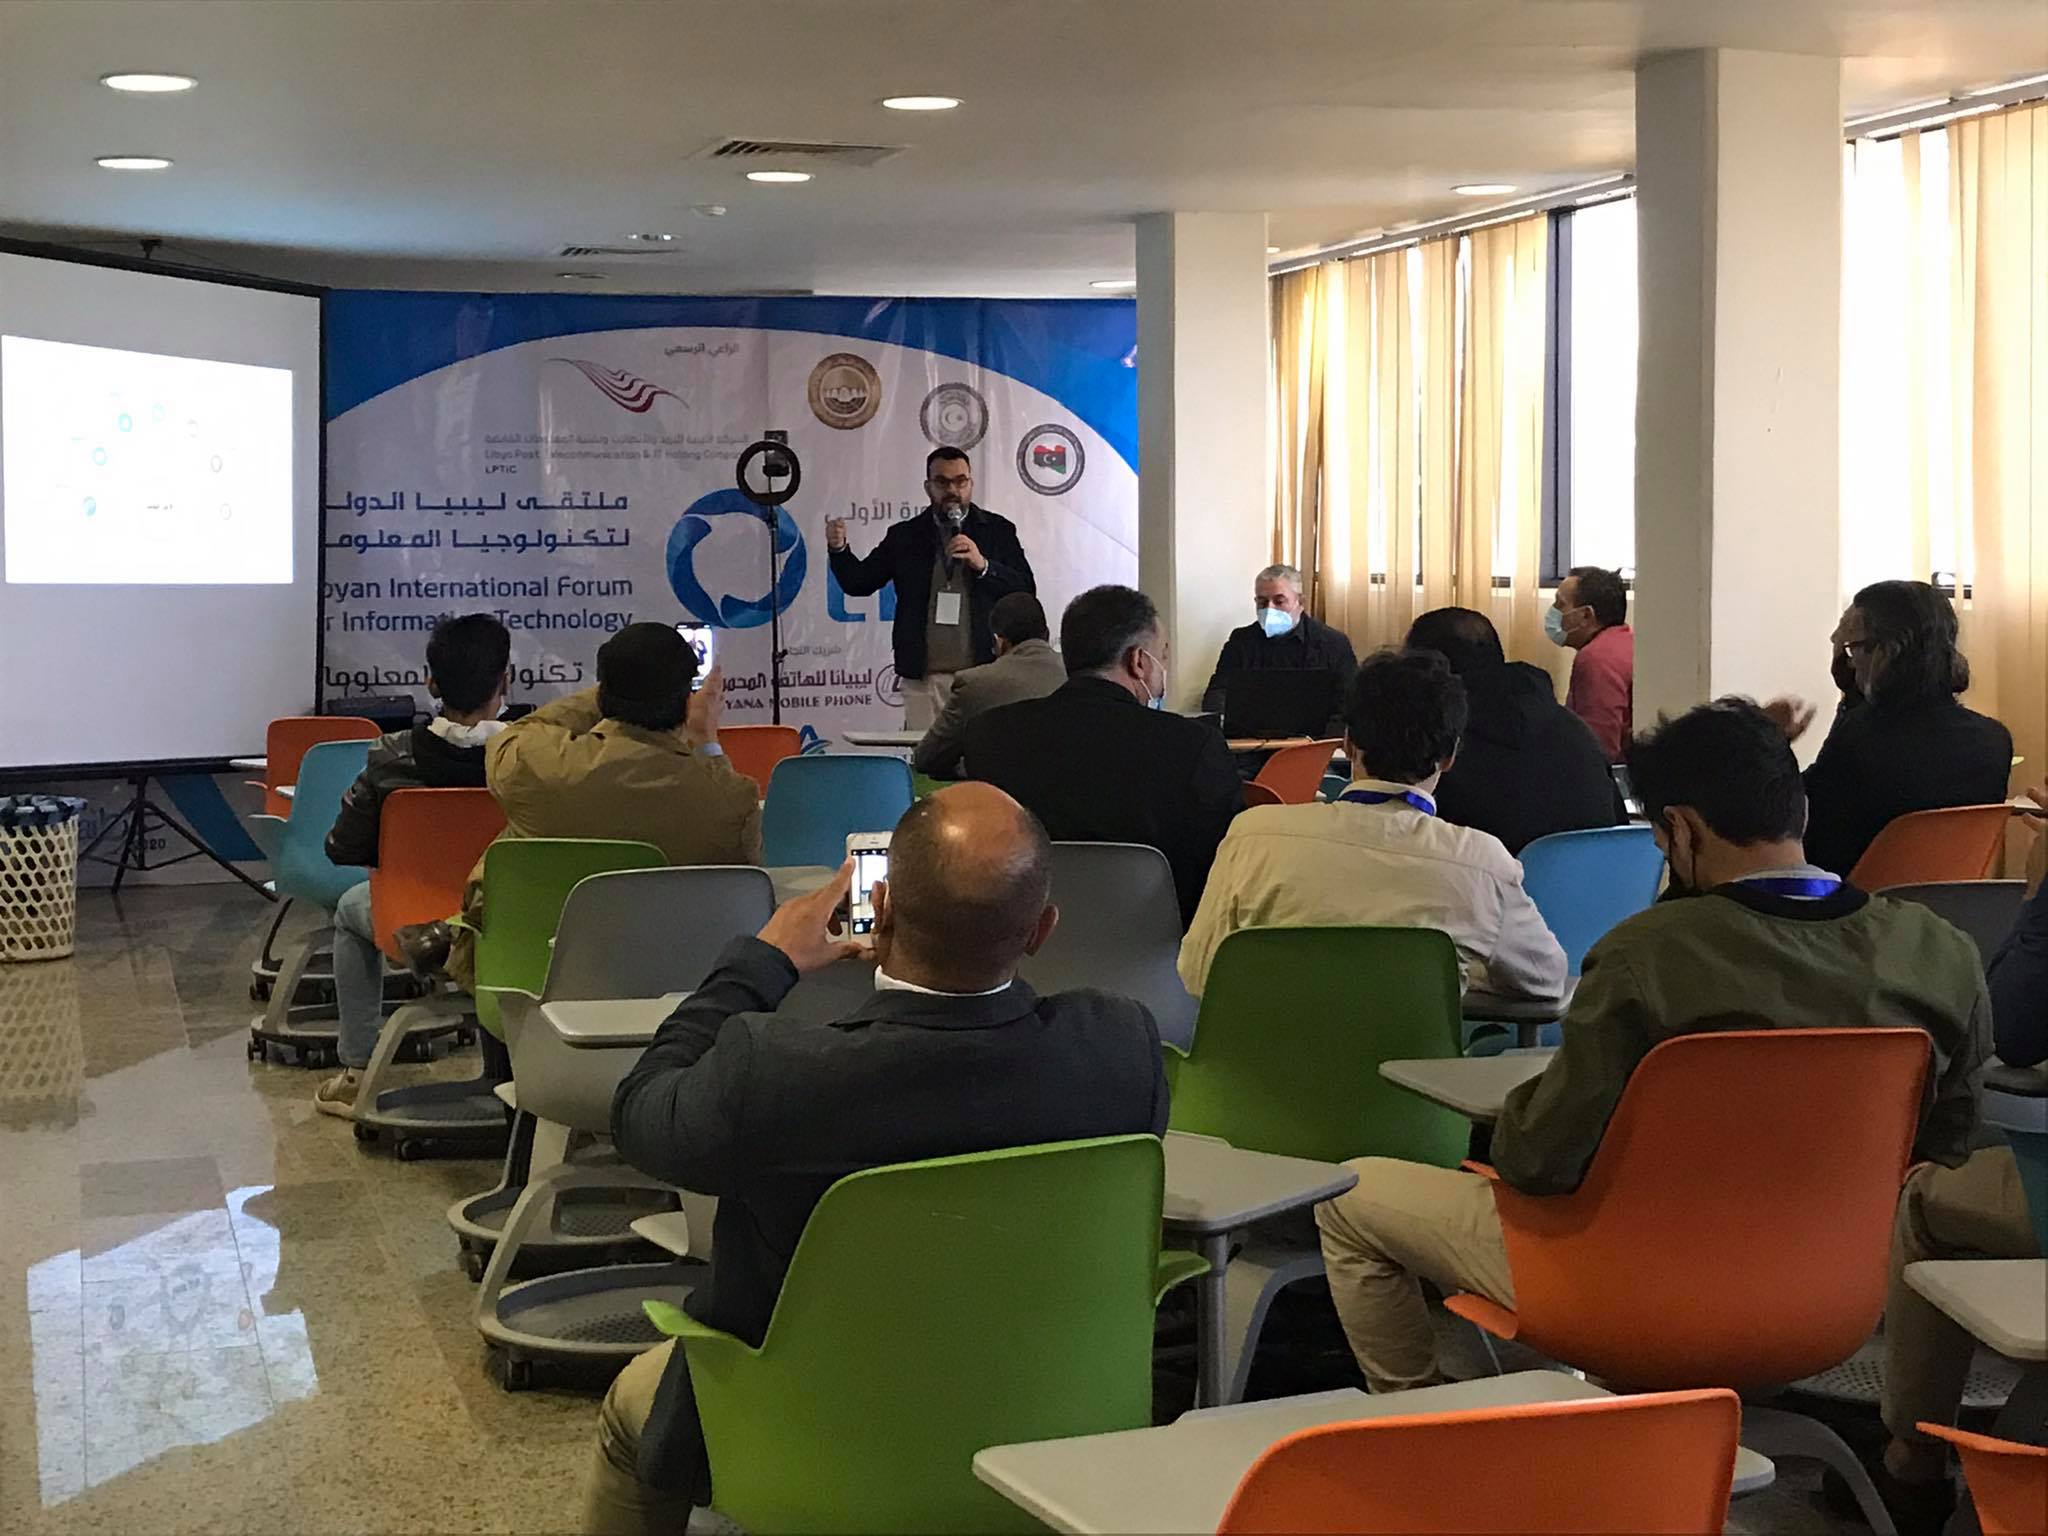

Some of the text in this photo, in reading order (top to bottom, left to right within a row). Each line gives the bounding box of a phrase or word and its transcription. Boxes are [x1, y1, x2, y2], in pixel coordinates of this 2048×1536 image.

[325, 491, 628, 517] ملتقى ليبيا الدول
[325, 528, 630, 555] لتكنولوجيا المعلوم
[390, 576, 548, 598] International
[557, 576, 633, 597] Forum
[494, 608, 633, 633] Technology
[510, 662, 582, 690] تكنول
[724, 698, 764, 710] YANA
[825, 695, 872, 707] PHONE
